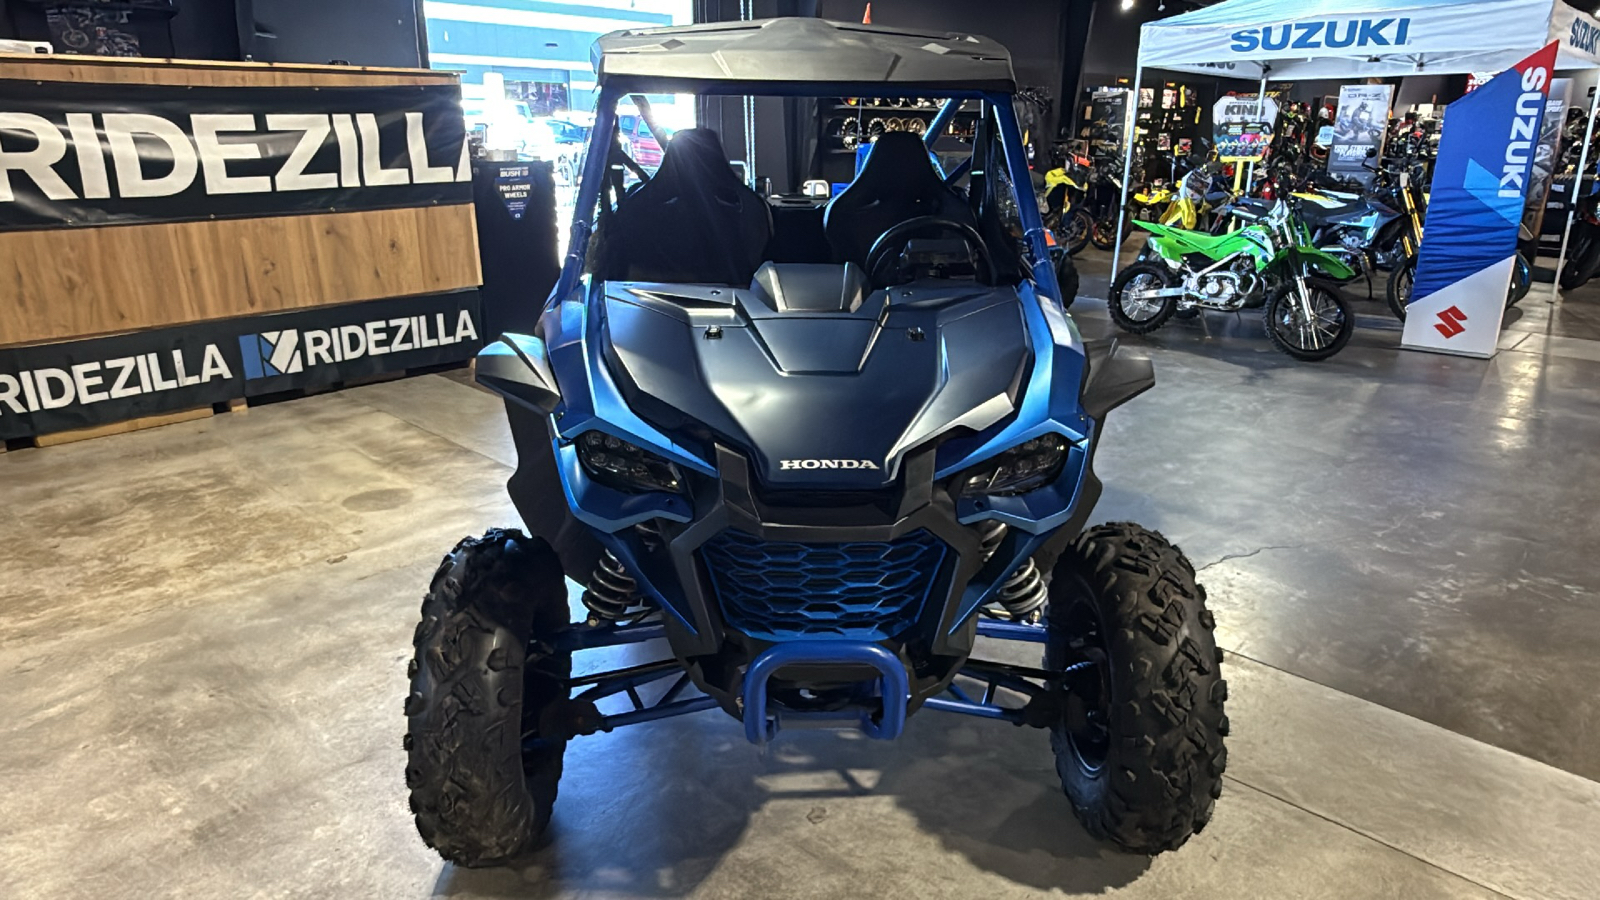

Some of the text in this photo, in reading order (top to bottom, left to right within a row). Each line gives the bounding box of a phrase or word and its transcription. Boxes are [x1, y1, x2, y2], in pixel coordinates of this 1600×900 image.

[1231, 18, 1410, 52] SUZUKI
[0, 112, 472, 201] RIDEZILL
[1498, 66, 1547, 198] SUZUKI
[304, 309, 478, 366] RIDEZILLA
[0, 343, 233, 416] RIDEZILLA
[780, 459, 880, 470] HONDA
